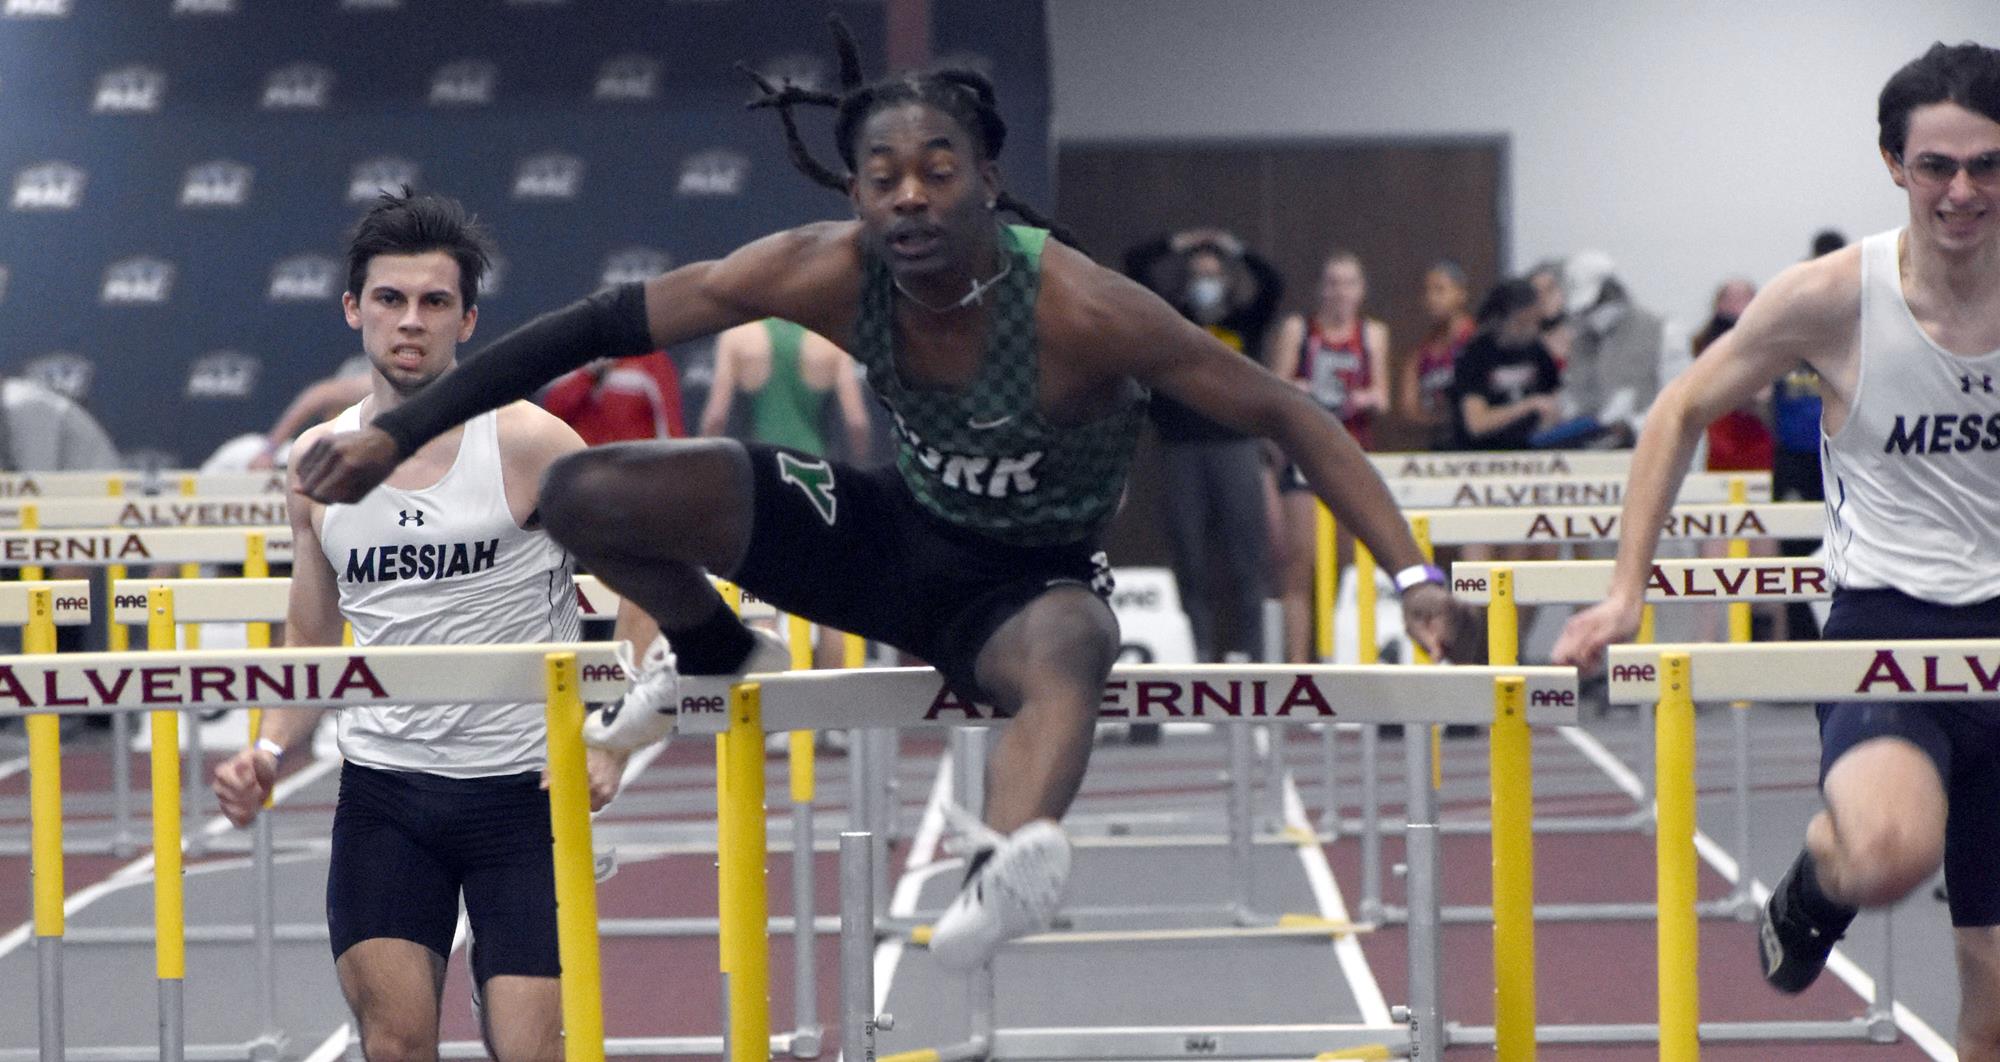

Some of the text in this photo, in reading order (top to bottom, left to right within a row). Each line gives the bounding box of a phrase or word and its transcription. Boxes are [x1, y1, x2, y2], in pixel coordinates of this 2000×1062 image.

[1401, 458, 1570, 477] ALVERNIA
[776, 452, 837, 526] Y
[1453, 483, 1622, 506] ALVERNI
[118, 502, 286, 526] ALVERNI
[1526, 510, 1767, 539] ALVRNIA
[5, 533, 151, 560] ERNIA
[345, 537, 500, 583] MESSIAH
[0, 656, 390, 707] ALVERNIA
[922, 674, 1338, 720] AERNIA
